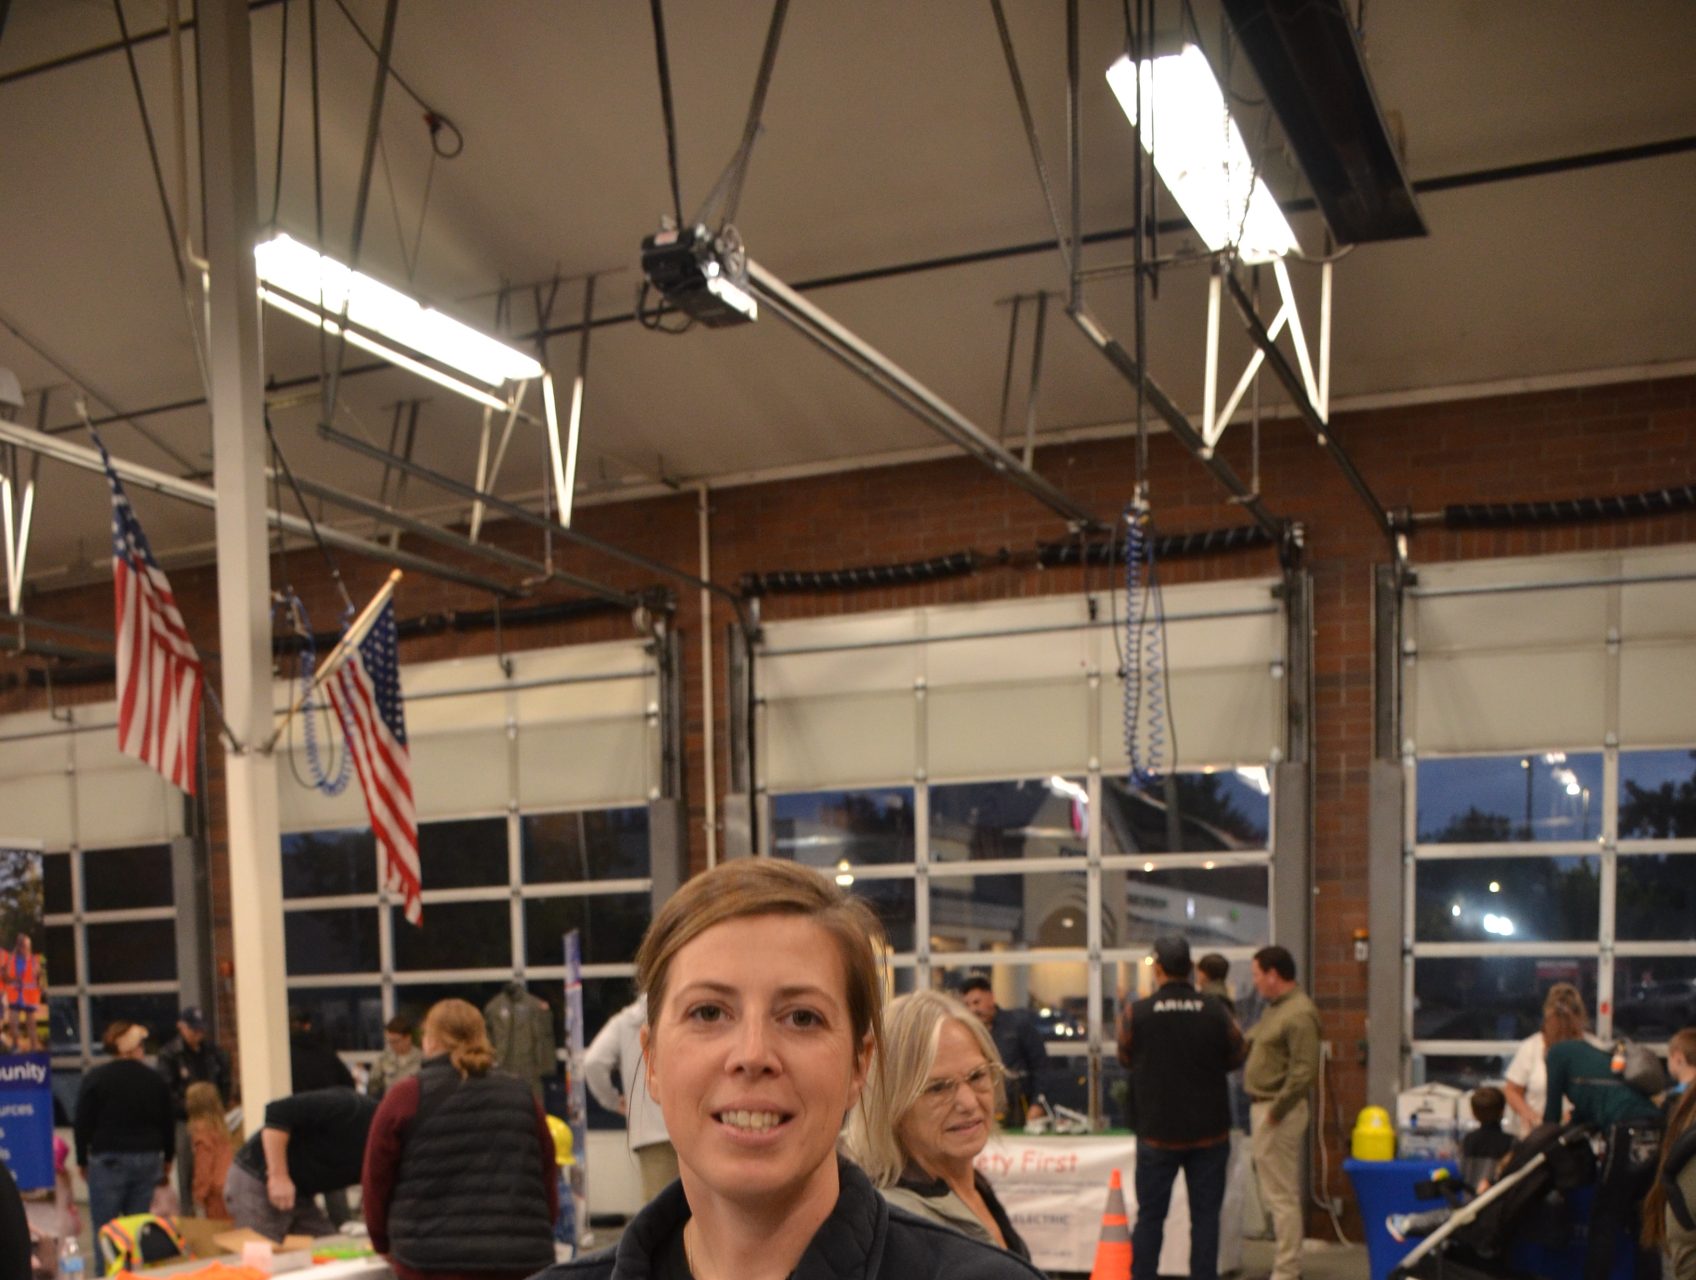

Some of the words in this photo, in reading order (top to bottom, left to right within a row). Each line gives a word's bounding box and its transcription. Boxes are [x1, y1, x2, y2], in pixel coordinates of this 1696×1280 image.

[1153, 999, 1204, 1012] ARIAT
[974, 1152, 1014, 1176] ety
[1021, 1149, 1079, 1174] First
